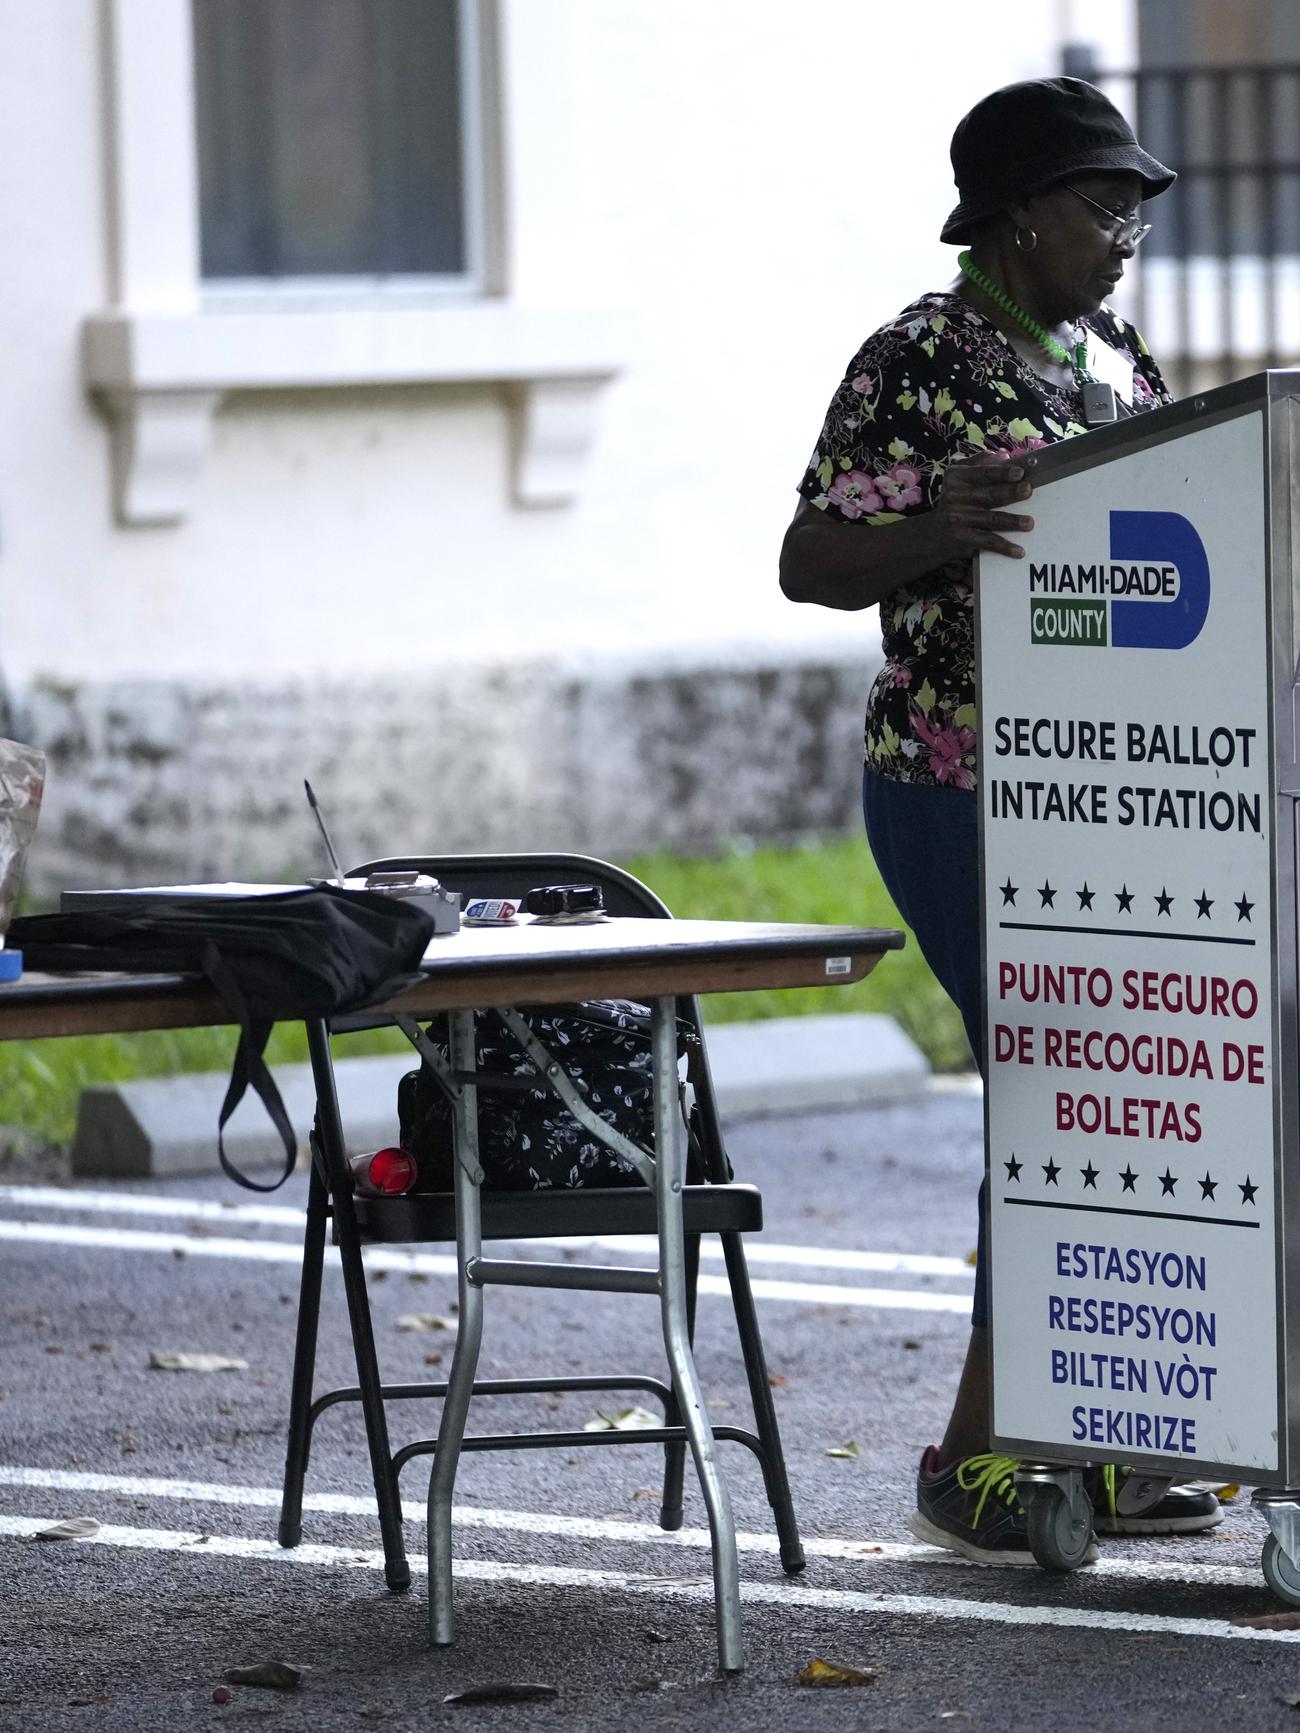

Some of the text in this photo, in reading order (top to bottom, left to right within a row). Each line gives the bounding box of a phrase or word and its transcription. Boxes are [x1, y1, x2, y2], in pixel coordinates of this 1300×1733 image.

[1032, 607, 1105, 639] COUNTY
[995, 716, 1256, 767] SECURE BALLOT
[991, 780, 1261, 832] INTAKE STATION
[999, 961, 1258, 1019] PUNTO SEGURO
[995, 1024, 1265, 1084] DE RECOGIDA DE
[1056, 1092, 1202, 1143] BOLETAS
[1056, 1241, 1206, 1291] ESTASYON
[1049, 1295, 1216, 1347] RESEPSYON
[1051, 1349, 1217, 1401] BILTEN VÒT
[1072, 1405, 1196, 1454] SEKIRIZE
